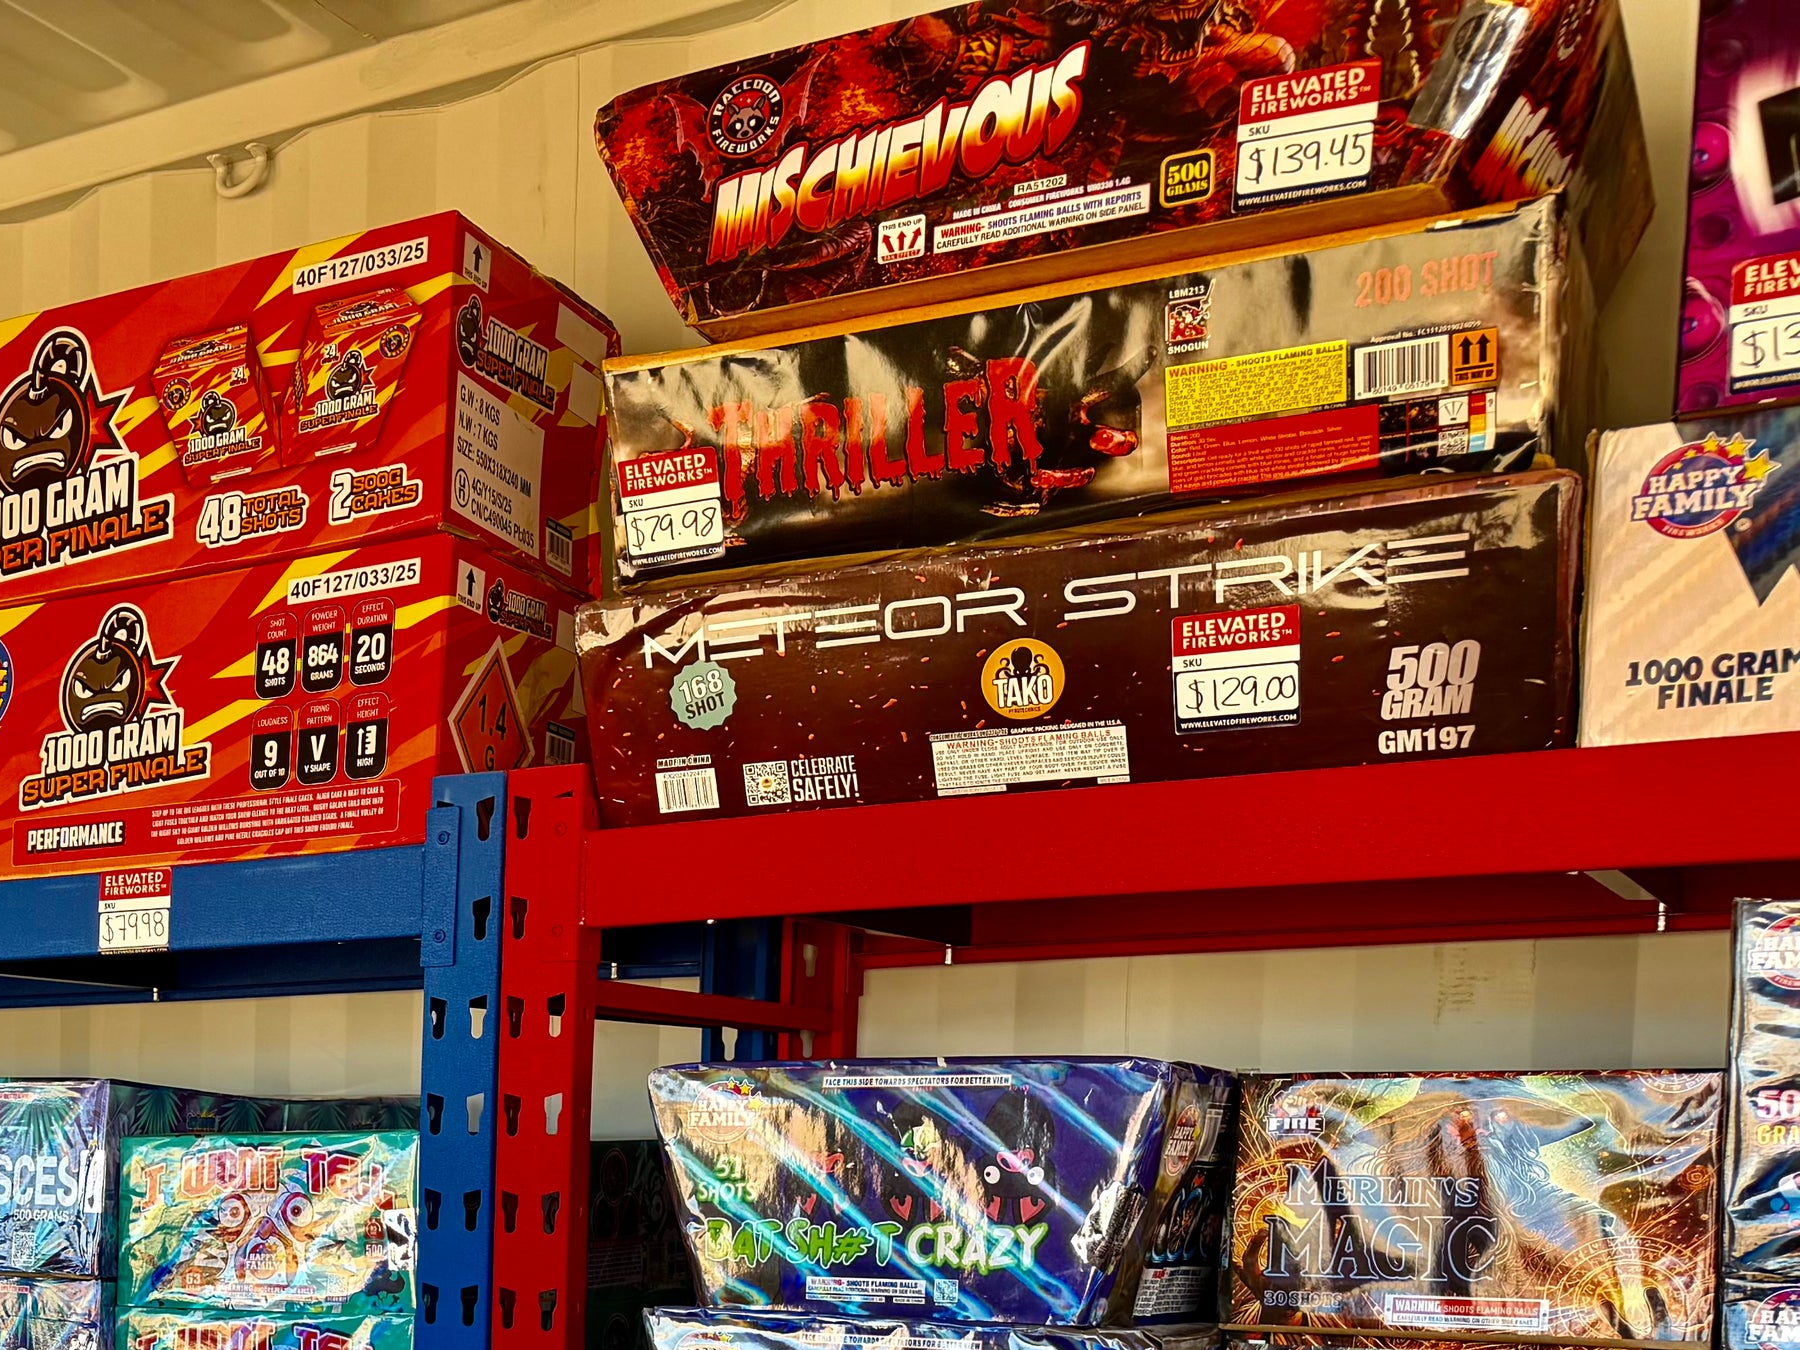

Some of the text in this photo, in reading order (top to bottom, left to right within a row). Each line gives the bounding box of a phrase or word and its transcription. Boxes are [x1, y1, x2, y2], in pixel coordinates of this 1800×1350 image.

[1251, 67, 1366, 104] ELEVATED
[1248, 123, 1271, 137] SKU
[705, 40, 1090, 266] MISCHIEVOUS
[1240, 132, 1369, 184] $139.45
[1017, 176, 1064, 194] RA51202
[1166, 178, 1208, 197] GRAMS
[1167, 158, 1209, 184] 500
[987, 214, 1018, 230] SHOOTS
[1019, 208, 1055, 225] FLAMING
[1056, 202, 1081, 218] BALLS
[1083, 198, 1103, 212] WITH
[1105, 190, 1142, 207] REPORTS
[296, 241, 426, 289] 40F127/033/25
[1355, 251, 1498, 309] 200 SHOT
[1167, 339, 1209, 355] SHOGUN
[625, 453, 706, 480] ELEVATED
[1648, 465, 1741, 494] HAPPY
[46, 462, 132, 531] GRAM
[1632, 479, 1758, 521] FAMILY
[198, 496, 242, 545] 48
[630, 506, 717, 551] $79.98
[290, 562, 418, 602] 40F127/033/25
[643, 532, 1471, 669] METEOR STRIKE
[1181, 612, 1286, 637] ELEVATED
[262, 647, 290, 677] 48
[307, 643, 339, 667] 864
[356, 632, 386, 663] 20
[1182, 656, 1203, 668] SKU
[1387, 639, 1481, 690] 500
[310, 670, 334, 681] GRAMS
[354, 662, 386, 675] SECONDS
[1625, 646, 1800, 687] 1000 GRAM
[678, 669, 725, 704] 168
[994, 673, 1054, 709] TAKO
[1187, 672, 1297, 713] $129.00
[1380, 684, 1475, 722] GRAM
[1657, 675, 1774, 711] FINALE
[684, 691, 727, 722] SHOT
[44, 714, 177, 771] 1000 GRAM
[1378, 724, 1477, 755] GM197
[23, 749, 206, 804] SUPER FINALE
[790, 755, 857, 778] CELEBRATE
[792, 773, 860, 803] SAFELY!
[27, 822, 125, 851] PERFORMANCE
[105, 872, 165, 888] ELEVATED
[101, 911, 166, 946] $79.98
[825, 1075, 1010, 1086] FACE THIS SIDE TOWARDS SPECTATORS FOR BETTER VIEW
[1285, 1157, 1479, 1208] MERLIN'S
[705, 1219, 1049, 1276] BAT SH#T CRAZY
[1264, 1212, 1499, 1283] MAGIC
